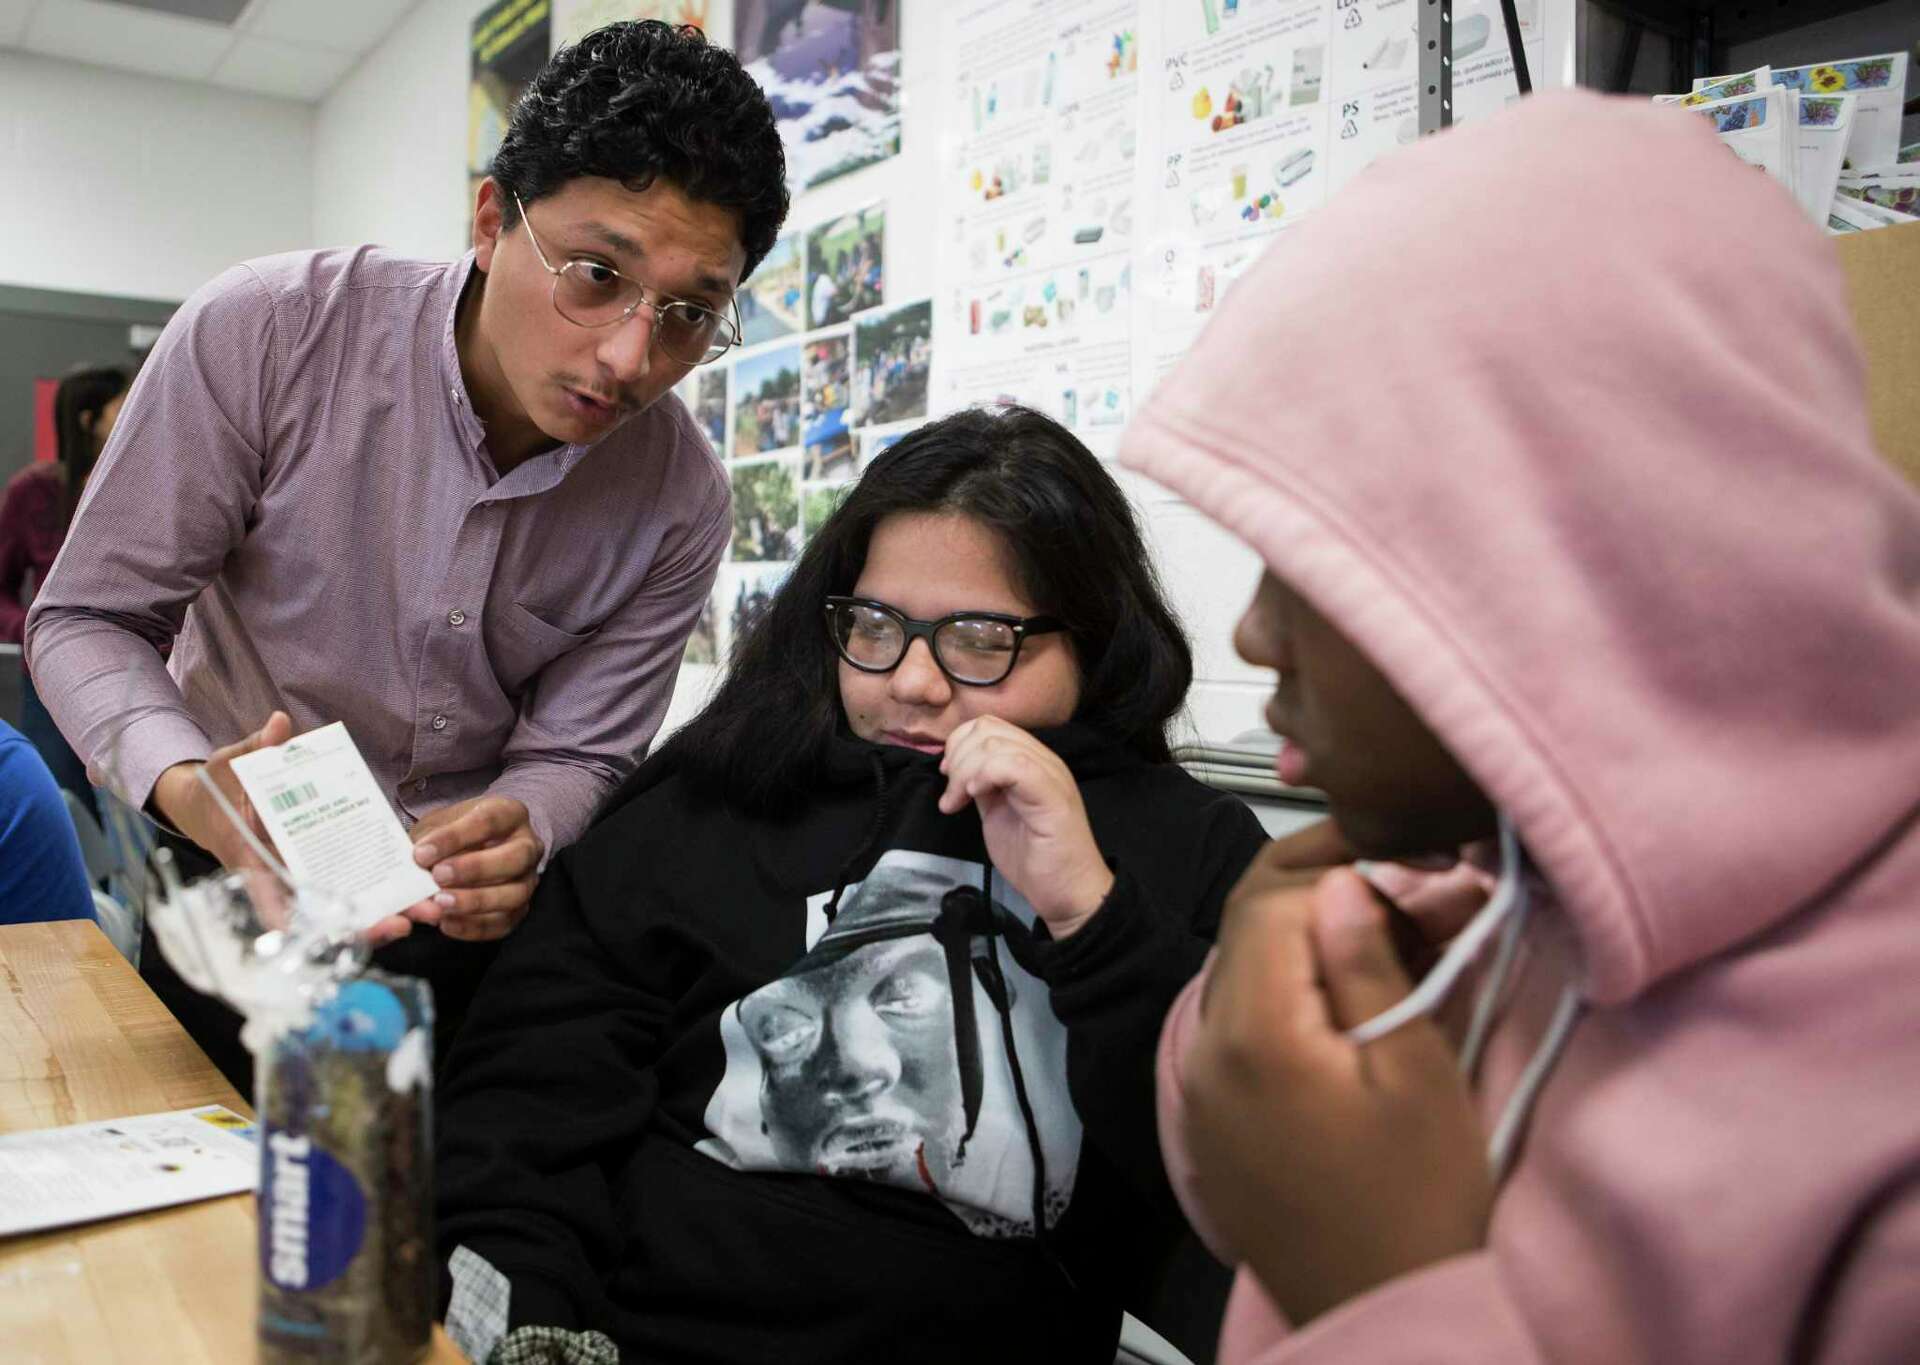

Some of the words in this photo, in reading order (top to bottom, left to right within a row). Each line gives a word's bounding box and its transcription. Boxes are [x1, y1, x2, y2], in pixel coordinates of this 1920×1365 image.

[1165, 51, 1188, 71] PVC
[1343, 101, 1359, 118] PS
[1167, 153, 1182, 168] PP
